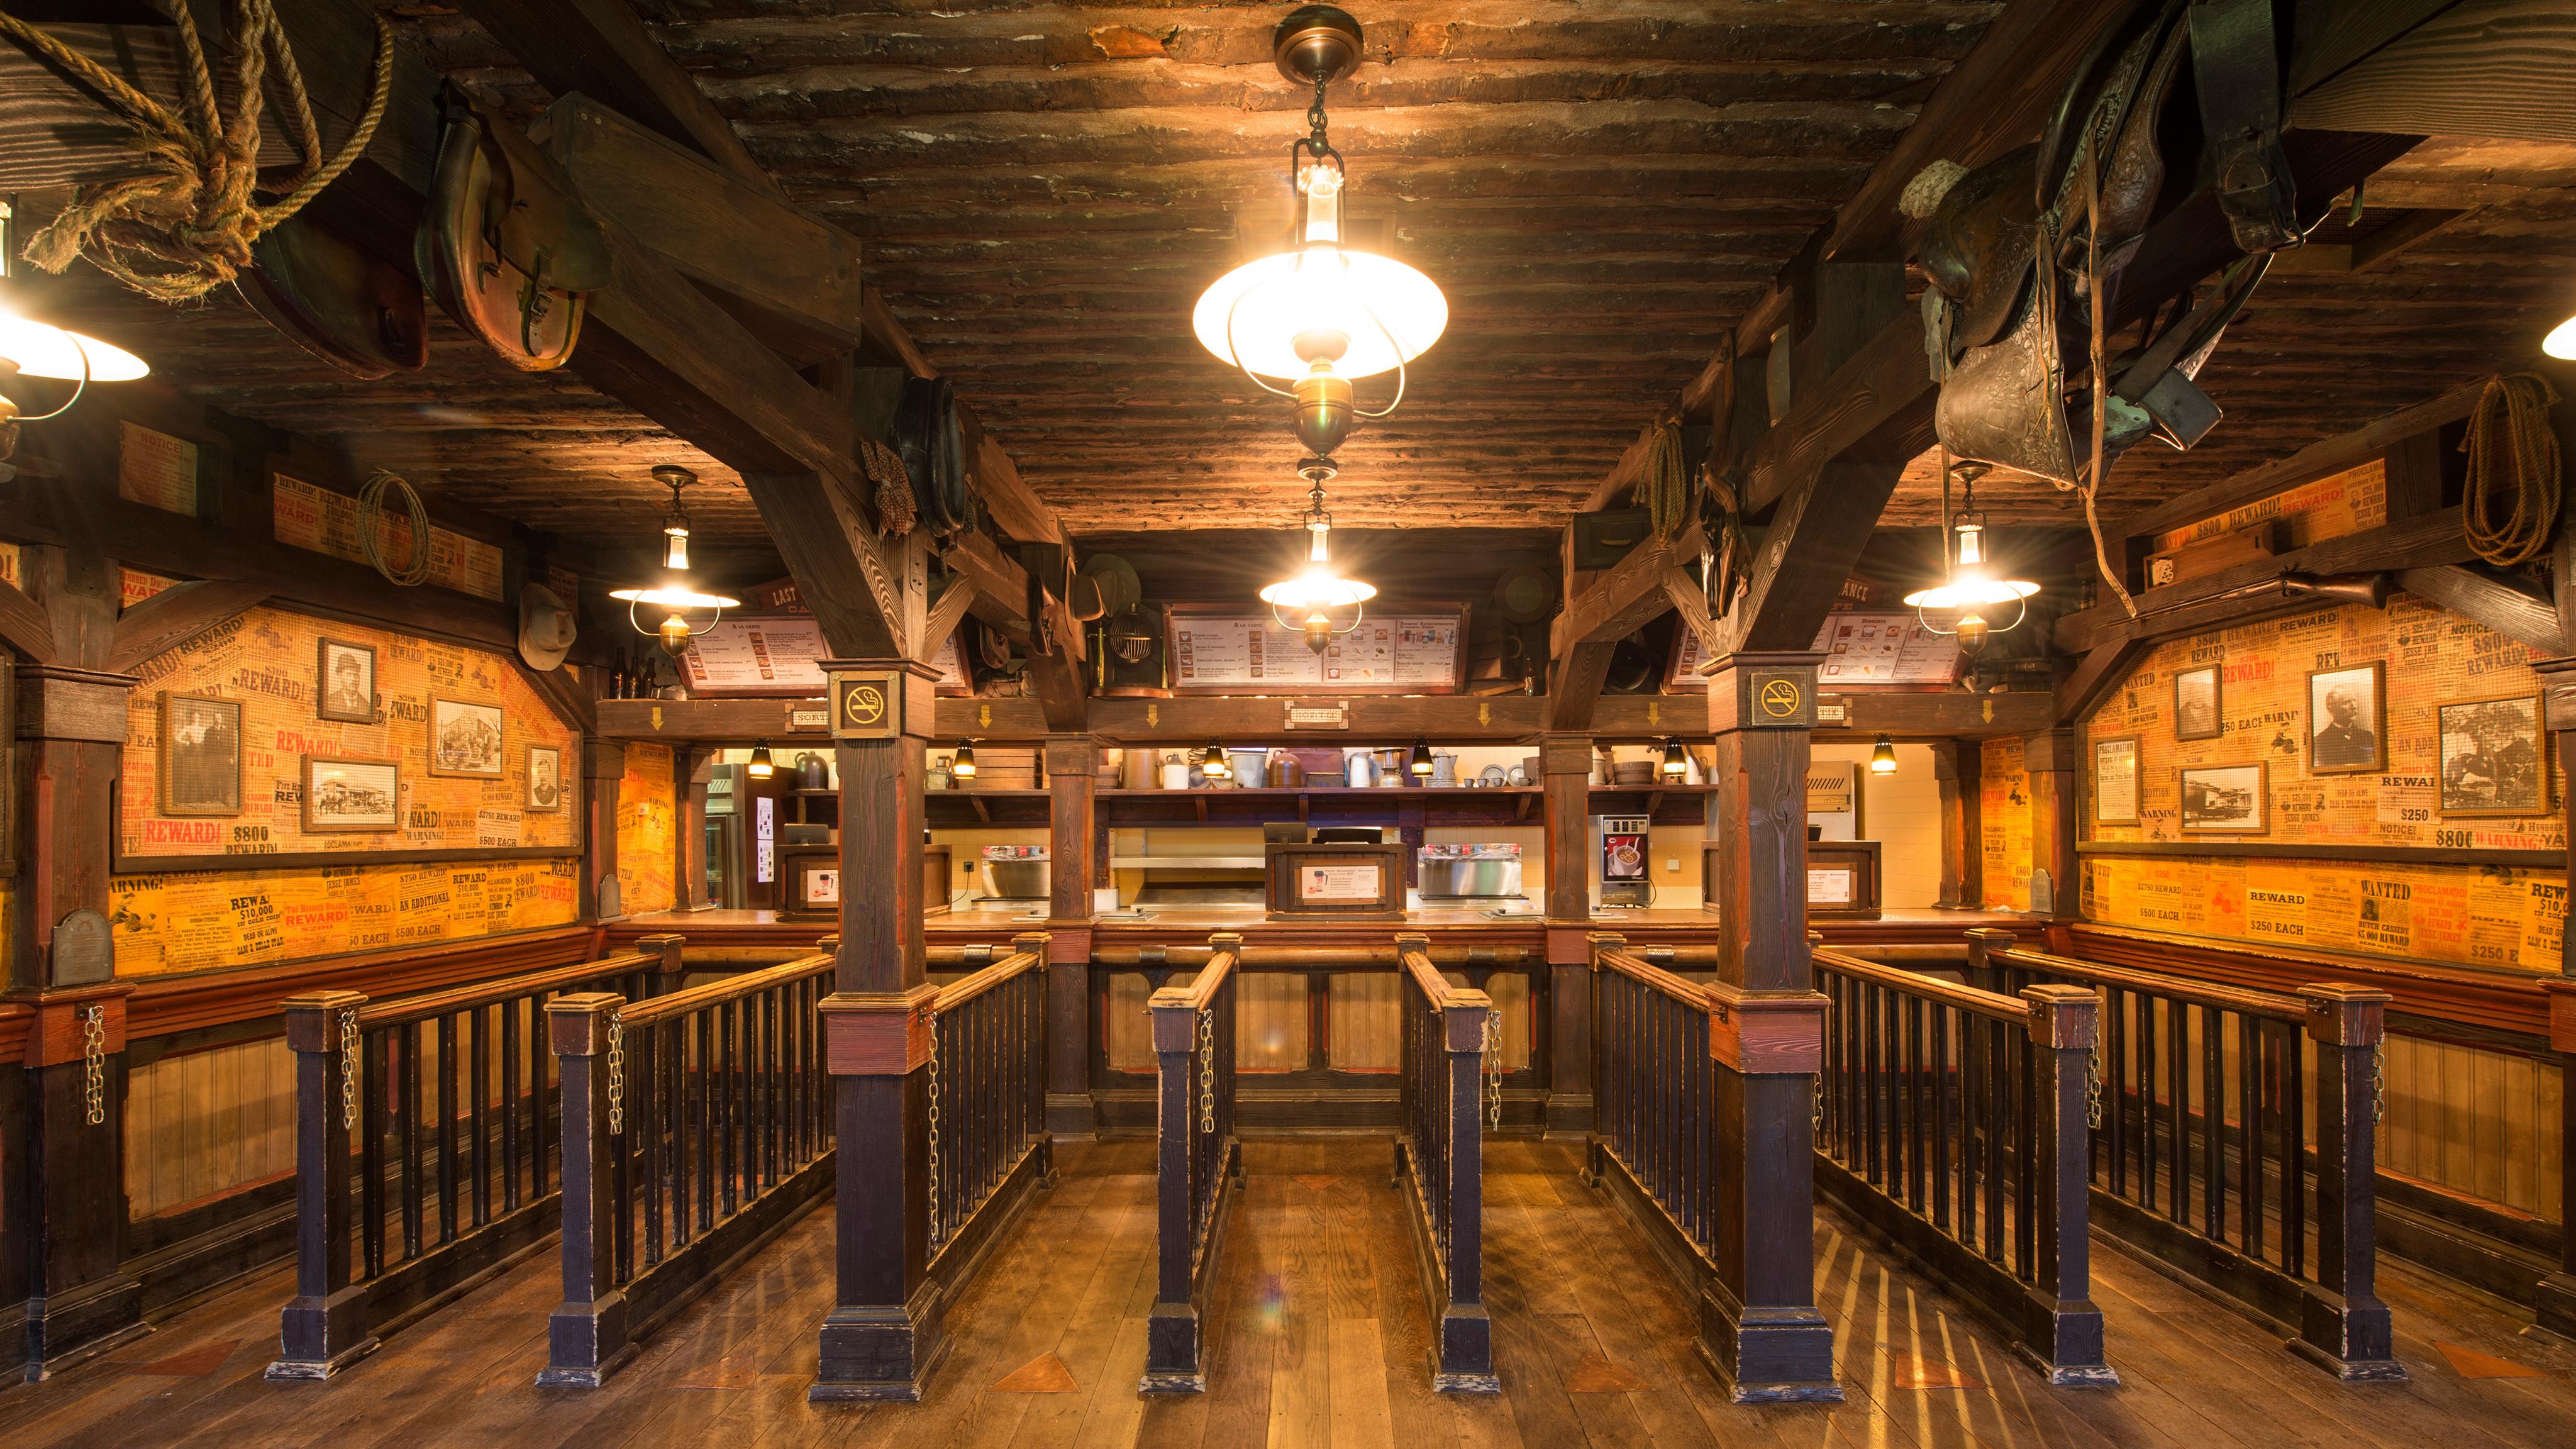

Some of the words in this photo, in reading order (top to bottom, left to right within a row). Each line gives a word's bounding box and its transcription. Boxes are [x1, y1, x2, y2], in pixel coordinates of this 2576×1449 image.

[141, 432, 182, 454] NOTICE!
[279, 478, 316, 496] REWARD!
[2362, 482, 2384, 496] $25,000
[2284, 487, 2344, 514] REWARD!
[2362, 493, 2384, 507] REWARD
[2229, 497, 2280, 528] REWARD!
[2354, 508, 2372, 523] JESSE
[2197, 519, 2221, 537] $800
[772, 587, 796, 606] LAST
[1839, 582, 1868, 601] ANCE
[2279, 612, 2340, 632] REWARD!
[179, 616, 245, 655] REWARD!
[2196, 631, 2221, 647] $800
[2412, 634, 2437, 645] REWARD
[2191, 645, 2225, 662] REWARD
[2403, 647, 2422, 660] JESSE
[2223, 660, 2275, 684] REWARD!
[240, 668, 305, 702] REWARD!
[2124, 673, 2155, 690] WANTED
[276, 730, 336, 755] REWARD!
[2099, 742, 2134, 755] PROCLAMATION
[2399, 739, 2411, 752] AN
[640, 750, 669, 758] REWARD!
[648, 796, 670, 810] WARNING!
[496, 812, 520, 823] REWARD
[2285, 814, 2300, 823] JESSE
[2302, 814, 2319, 823] JAMES
[2401, 809, 2429, 821] $250
[145, 820, 220, 844] REWARD!
[234, 826, 269, 842] $800
[406, 831, 444, 841] WARNING!
[2380, 824, 2416, 835] NOTICE!
[479, 836, 495, 846] $500
[497, 837, 516, 847] EACH
[2475, 831, 2546, 849] WARNING!
[497, 862, 518, 871] EACH
[2016, 865, 2030, 876] $800
[2336, 859, 2365, 868] EACH
[400, 874, 417, 883] $750
[419, 868, 447, 879] REWARD!
[453, 873, 487, 884] REWARD
[515, 872, 535, 887] $800
[326, 880, 342, 891] JESSE
[343, 877, 360, 888] JAMES
[458, 884, 479, 893] $10,000
[2138, 882, 2153, 891] $2750
[2155, 884, 2182, 894] REWARD
[2360, 880, 2411, 901] WANTED
[540, 884, 575, 903] REWARD!
[2250, 892, 2305, 904] REWARD
[400, 900, 409, 911] AN
[411, 892, 450, 909] ADDITIONAL
[240, 905, 273, 920] $10,000
[286, 911, 347, 926] REWARD!
[2140, 908, 2156, 918] $500
[2158, 910, 2179, 921] EACH
[301, 924, 333, 932] $200
[396, 927, 414, 938] $500
[418, 924, 440, 936] EACH
[2250, 921, 2272, 931] $250
[2275, 923, 2304, 935] EACH
[2359, 921, 2379, 930] BUTCH
[2382, 924, 2409, 935] CASSIDY
[2428, 918, 2451, 930] REWARD
[2538, 925, 2553, 936] DEAD
[243, 931, 255, 941] DEAD
[265, 928, 278, 936] ALIVE
[362, 933, 389, 944] EACH
[2358, 930, 2378, 940] $5,000
[2380, 931, 2409, 947] REWARD
[2418, 928, 2438, 940] JESSE
[2440, 930, 2462, 943] JAMES
[2472, 945, 2504, 960] $250
